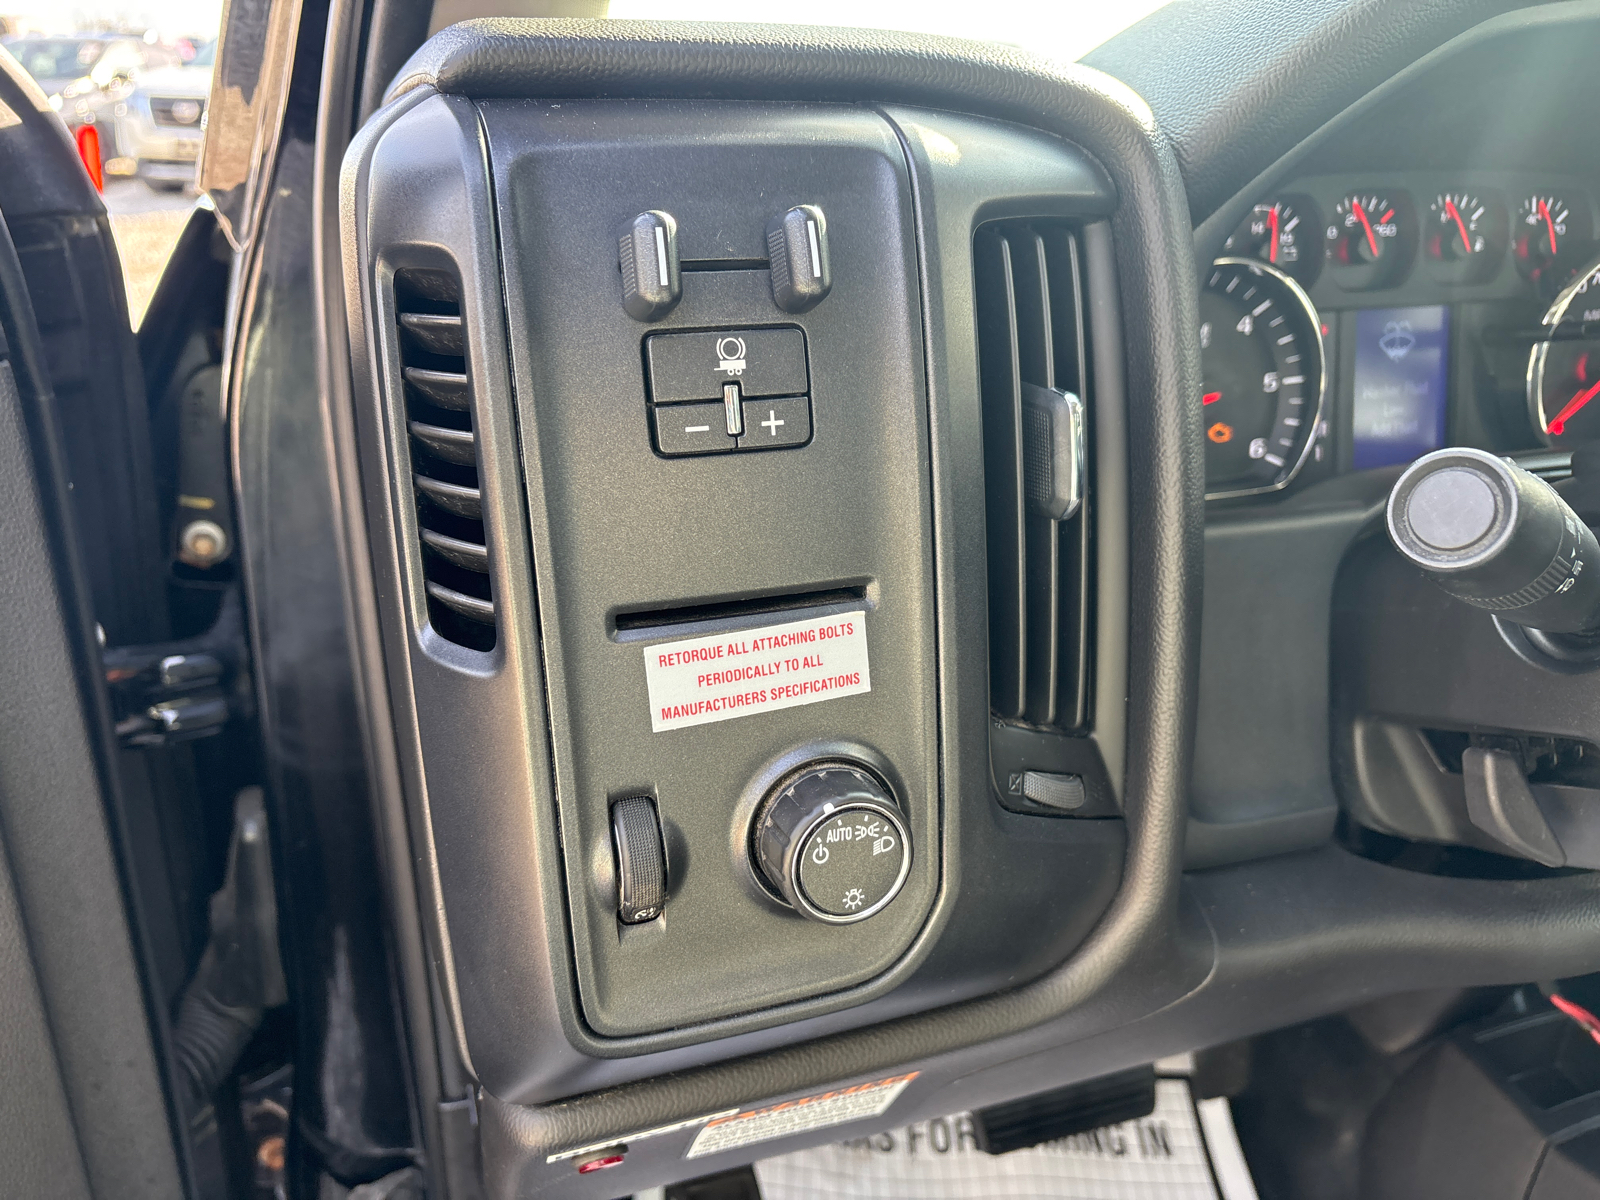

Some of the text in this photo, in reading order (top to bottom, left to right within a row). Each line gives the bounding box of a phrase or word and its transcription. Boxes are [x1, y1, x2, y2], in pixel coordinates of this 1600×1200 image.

[1237, 314, 1253, 336] 4
[1263, 371, 1280, 393] 5
[1249, 437, 1267, 459] 6
[659, 622, 854, 667] RETORQUE ALL ATTACHING BOLTS
[698, 654, 824, 687] PERIODICALLY TO ALL
[661, 672, 860, 720] MANUFACTURERS SPECIFICATIONS
[826, 826, 852, 843] AUTO
